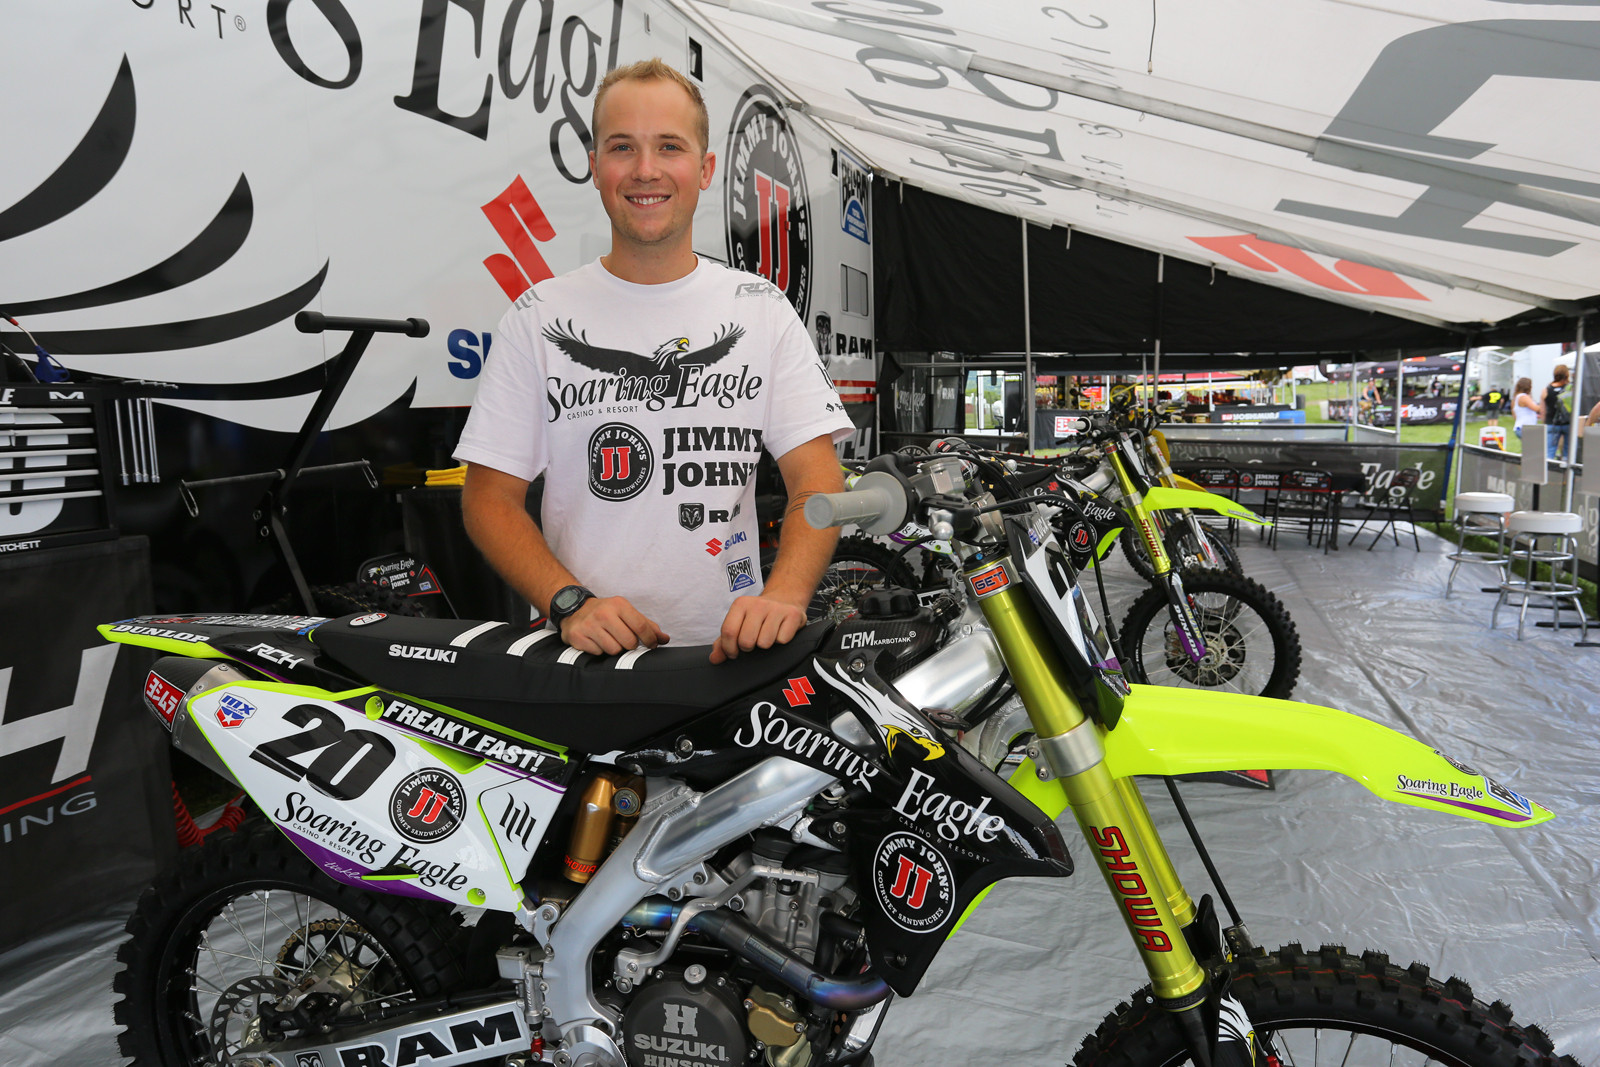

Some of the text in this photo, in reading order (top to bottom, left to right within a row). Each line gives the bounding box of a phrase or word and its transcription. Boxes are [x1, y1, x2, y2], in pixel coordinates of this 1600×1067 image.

[733, 113, 767, 220] JIMMY
[754, 168, 791, 292] JJ
[836, 333, 873, 360] RAM
[546, 363, 763, 423] Soaring Eagle
[567, 409, 594, 421] CASINO
[606, 406, 639, 414] RESORT
[615, 429, 647, 461] JOHN'S
[662, 426, 763, 460] JIMMY
[600, 446, 632, 481] JJ
[613, 467, 647, 495] SANDWICHES
[1083, 501, 1116, 521] Eagle
[1139, 518, 1163, 558] SHOWA
[389, 572, 408, 583] JIMMY
[400, 557, 415, 571] Eagle
[974, 570, 1003, 590] GET
[111, 623, 210, 644] DUNLOP
[840, 630, 876, 650] CRM
[1172, 604, 1200, 657] DUNLOP
[247, 642, 305, 670] RCH
[388, 643, 458, 664] SUZUKI
[248, 703, 397, 802] 20
[382, 700, 547, 773] FREAKY FAST!
[733, 701, 1005, 843] Soaring Eagle
[1396, 773, 1447, 796] Soaring
[1449, 782, 1484, 801] Eagle
[401, 774, 460, 816] JIMMY JOHN'S
[406, 786, 450, 825] JJ
[396, 799, 453, 837] GOURMET SANDWICHES
[274, 791, 468, 891] Soaring Eagle
[292, 822, 320, 840] CASINO
[328, 840, 355, 857] RESORT
[898, 815, 932, 839] CASINO
[948, 842, 988, 863] RESORT
[879, 837, 950, 901] JIMMY JOHN'S
[889, 854, 934, 910] JJ
[877, 870, 944, 926] GOURMET SANDWICHES
[1089, 825, 1173, 953] SHOWA
[338, 1010, 523, 1067] RAM
[663, 1002, 699, 1038] H
[634, 1033, 726, 1062] SUZUKI
